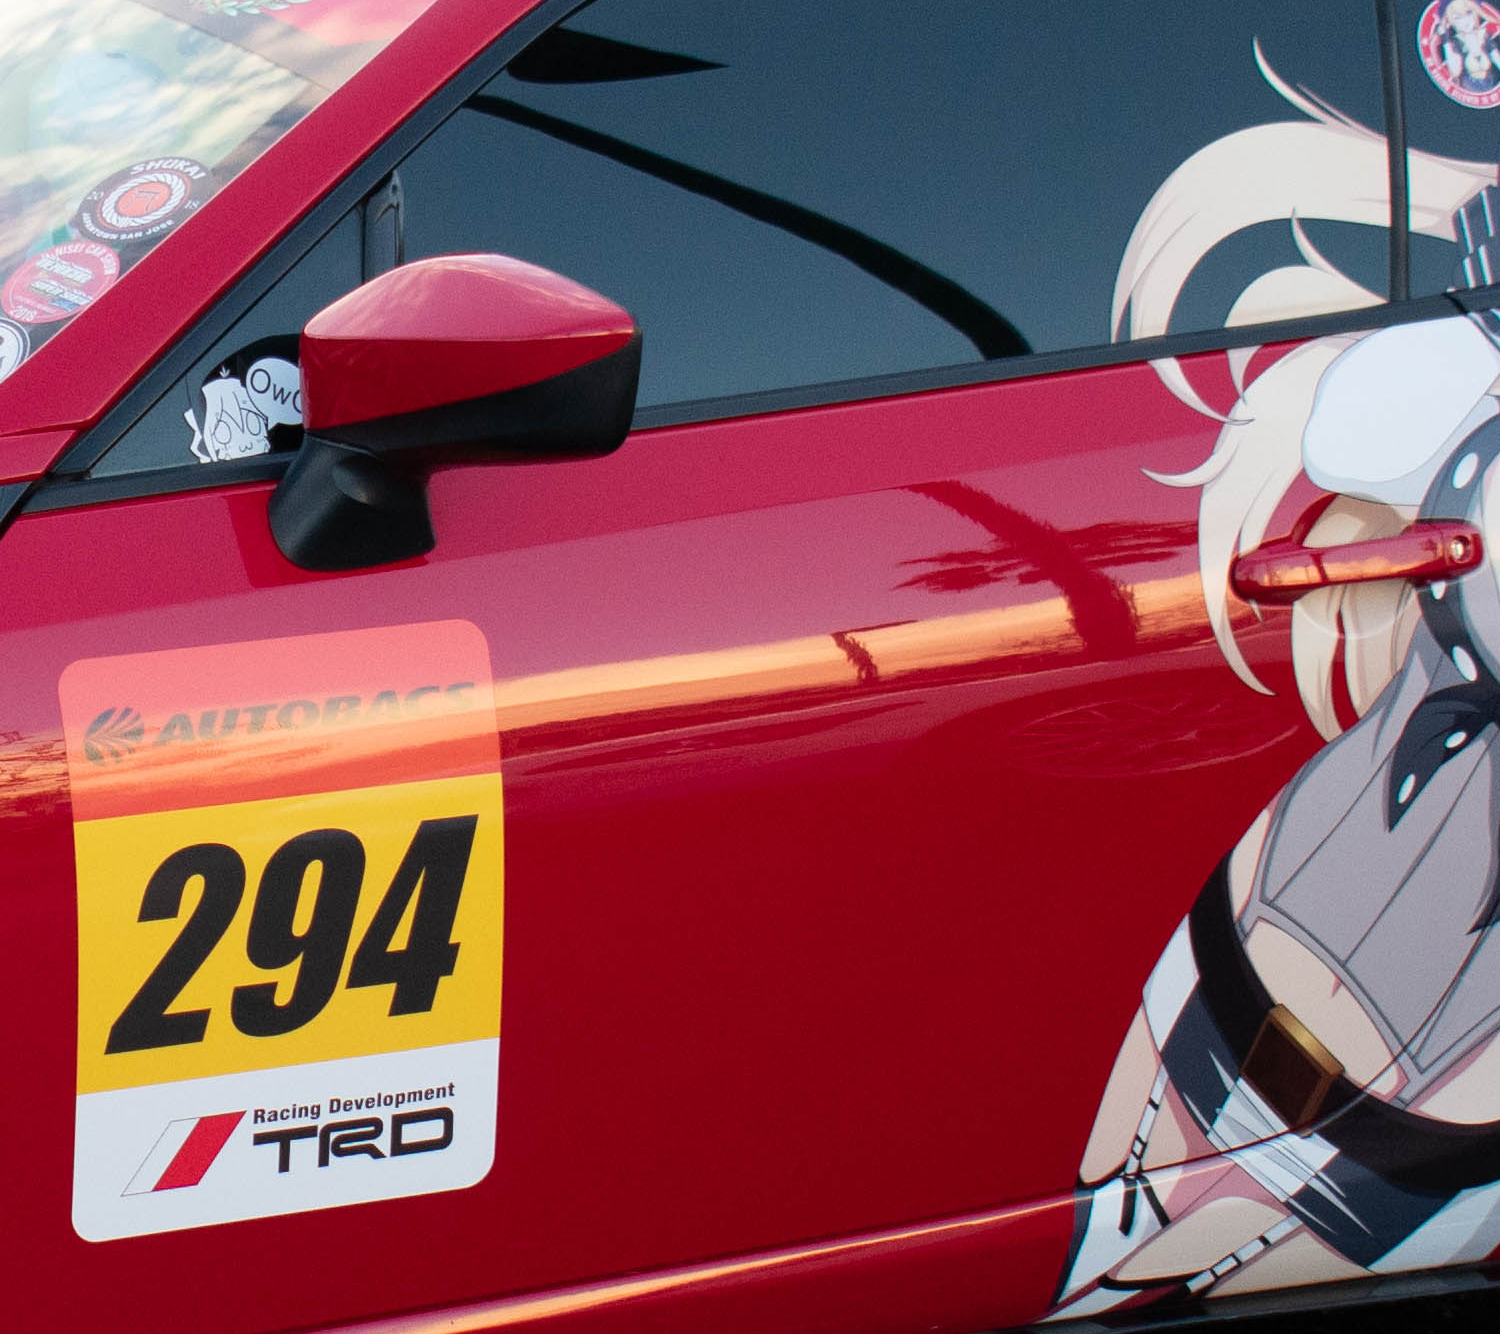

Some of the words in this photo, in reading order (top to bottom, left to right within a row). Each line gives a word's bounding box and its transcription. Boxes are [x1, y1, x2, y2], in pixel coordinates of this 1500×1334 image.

[153, 682, 477, 747] AUTOBACS
[104, 813, 479, 1055] 294
[252, 1100, 321, 1125] Racing
[328, 1081, 456, 1115] Development
[252, 1106, 454, 1174] TRD
